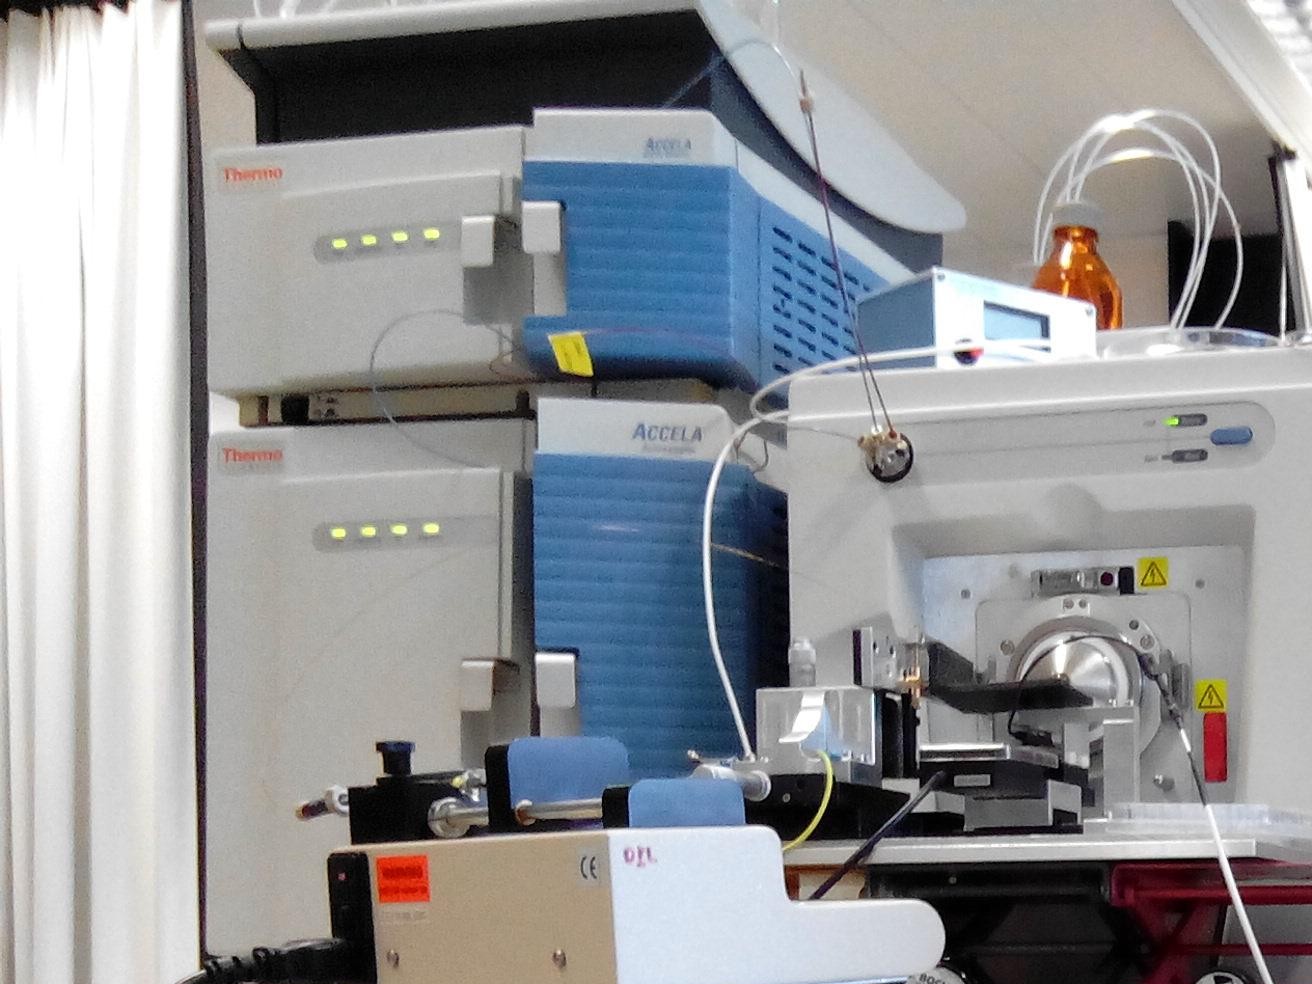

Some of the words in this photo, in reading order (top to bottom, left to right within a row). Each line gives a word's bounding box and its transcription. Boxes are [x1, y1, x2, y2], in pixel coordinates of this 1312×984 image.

[223, 166, 283, 181] Thermo
[632, 422, 703, 441] ACCELA
[222, 446, 284, 463] Thermo
